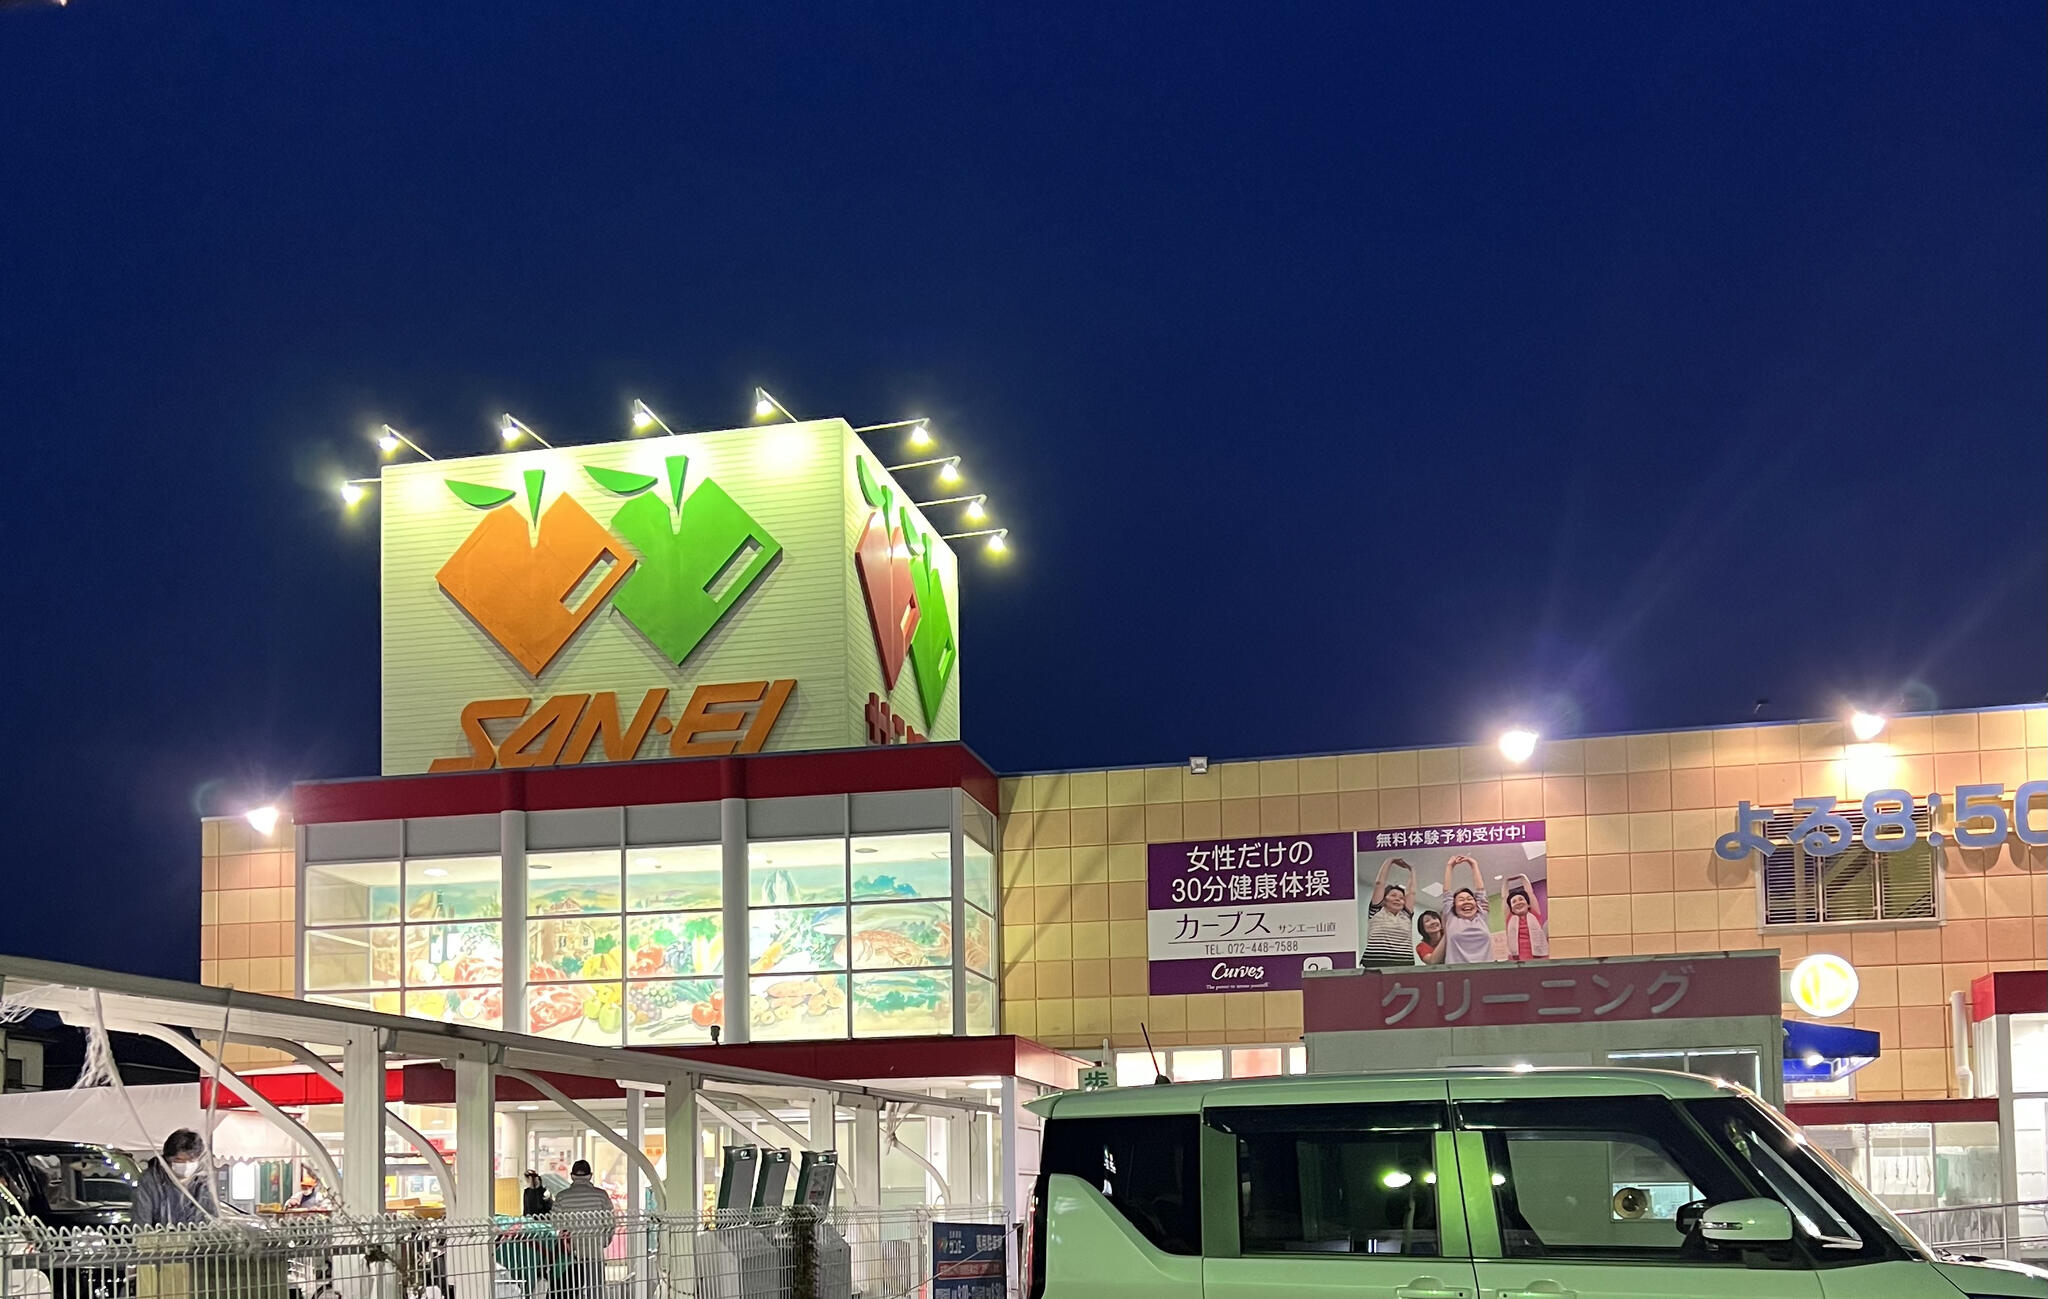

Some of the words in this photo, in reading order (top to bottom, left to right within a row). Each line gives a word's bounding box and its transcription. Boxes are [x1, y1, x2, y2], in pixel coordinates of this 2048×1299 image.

[1375, 824, 1527, 849] 無料体験予約受付中!
[1186, 840, 1313, 873] 女性だけの
[1171, 869, 1331, 903] 30分健康体操
[1174, 911, 1271, 941] カーブス
[1278, 922, 1337, 935] サンエー山直
[1227, 940, 1299, 955] 072-448-7588
[1211, 962, 1265, 981] Curves
[1381, 965, 1696, 1025] クリーニング
